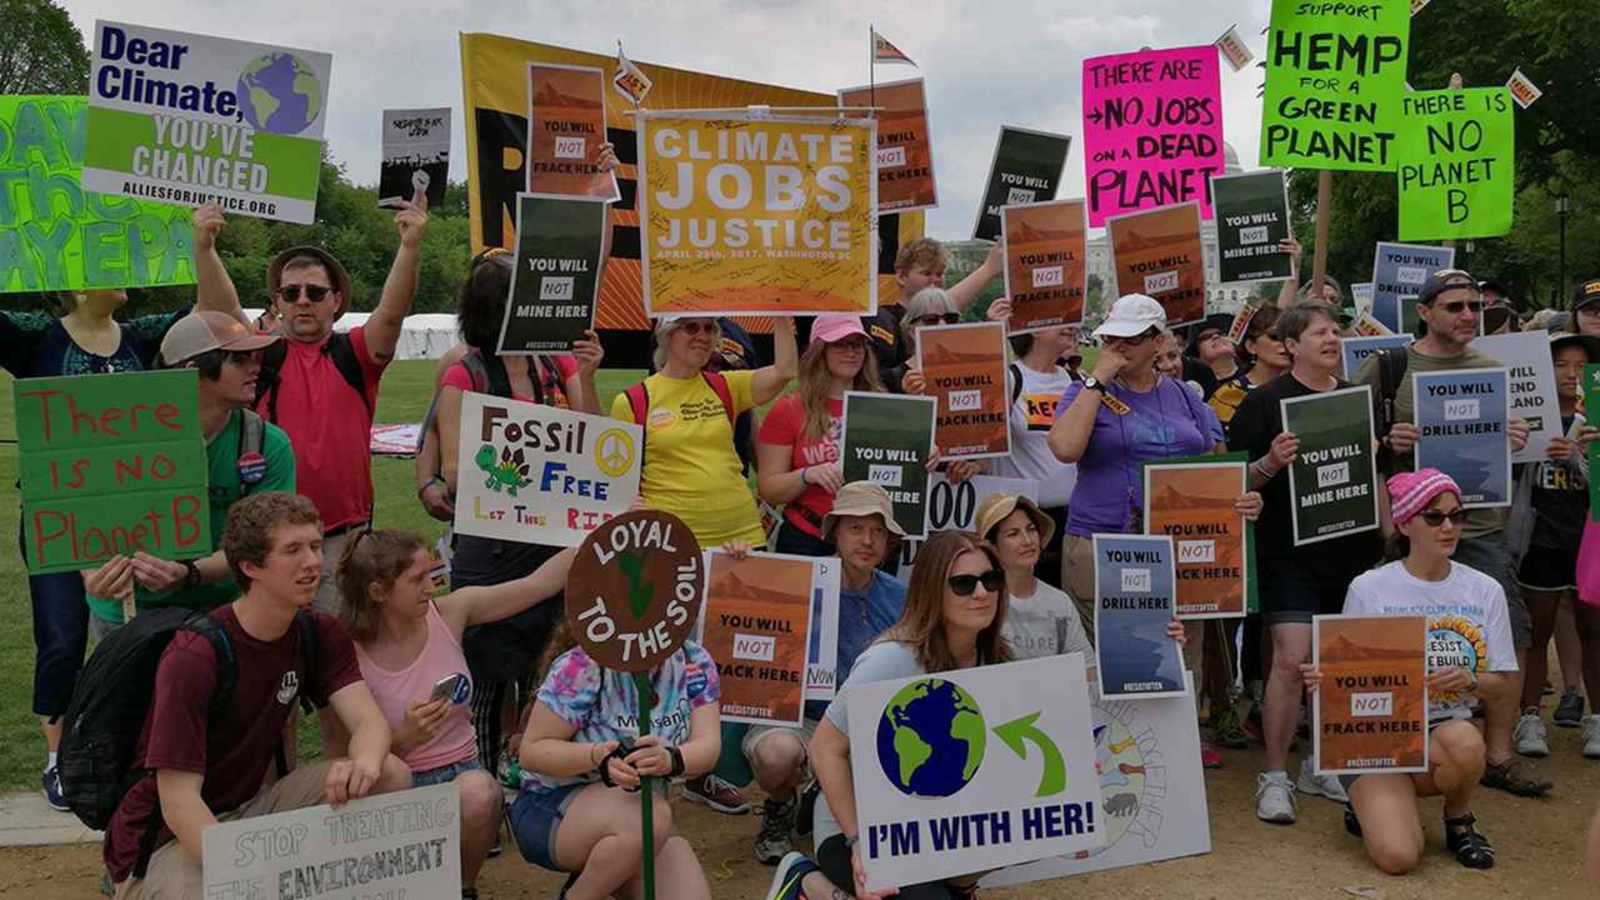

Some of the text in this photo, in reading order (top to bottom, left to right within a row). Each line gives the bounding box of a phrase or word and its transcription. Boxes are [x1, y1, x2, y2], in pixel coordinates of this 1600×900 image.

[1295, 2, 1383, 21] SUPPORT
[101, 26, 188, 70] Dear
[1274, 29, 1402, 77] HEMP
[1089, 59, 1203, 88] THERE ARE
[1299, 77, 1360, 94] FOR A
[97, 65, 243, 123] Climate,
[1278, 96, 1377, 125] GREEN
[1402, 93, 1507, 116] THERE IS
[1104, 96, 1215, 130] NO JOBS
[544, 120, 596, 134] YOU WILL
[154, 114, 254, 158] YOU'VE
[887, 130, 917, 142] WILL
[1426, 119, 1482, 155] NO
[557, 140, 583, 154] NOT
[654, 128, 854, 163] CLIMATE
[1093, 133, 1217, 162] ON A DEAD
[1267, 125, 1395, 165] PLANET
[132, 145, 268, 195] CHANGED
[533, 162, 601, 175] FRACK HER
[1402, 158, 1496, 191] PLANET
[655, 162, 851, 212] JOBS
[1001, 173, 1049, 190] YOU WILL
[1090, 166, 1218, 212] PLANET
[123, 181, 276, 216] ALLIESFORJUSTICE.ORG
[1447, 189, 1469, 224] B
[1225, 212, 1278, 227] YOU WILL
[657, 218, 851, 250] JUSTICE
[1243, 230, 1265, 241] NOT
[657, 250, 690, 259] APRIL
[1019, 251, 1075, 266] YOU WILL
[1223, 244, 1281, 259] MINE HER
[528, 258, 588, 272] YOU WILL
[1130, 254, 1190, 274] YOU WILL
[1387, 254, 1440, 267] YOU WILL
[1034, 269, 1062, 283] NOT
[1148, 276, 1176, 289] NOT
[1400, 270, 1423, 280] NOT
[543, 282, 571, 295] NOT
[1013, 287, 1082, 304] FRACK HERE
[1378, 283, 1409, 294] DRILL
[516, 305, 588, 318] MINE HERE
[1353, 349, 1374, 359] YO
[934, 375, 993, 388] YOU WILL
[1428, 383, 1494, 397] YOU WILL
[951, 394, 979, 406] NOT
[20, 389, 181, 442] There
[1449, 404, 1474, 416] NOT
[937, 412, 1004, 427] RACK HERE
[1423, 422, 1501, 436] DRILL HERE
[855, 447, 918, 462] YOU WILL
[1302, 443, 1361, 465] YOU WILL
[872, 470, 898, 481] NOT
[1320, 468, 1345, 481] NOT
[1301, 484, 1369, 507] MINE HERE
[33, 494, 201, 564] Planet B
[1163, 523, 1229, 536] YOU WILL
[593, 519, 677, 565] LOYAL
[1106, 550, 1162, 564] YOU WILL
[1181, 545, 1211, 558] NOT
[1124, 573, 1148, 587] NOT
[1204, 567, 1240, 579] HERE
[578, 556, 697, 661] TO THE SOIL
[1102, 598, 1136, 610] DRILL
[1138, 598, 1169, 610] HERE
[720, 614, 793, 633] YOU WILL
[737, 640, 771, 655] NOT
[1428, 641, 1463, 652] ESIST
[1437, 656, 1470, 667] BUILD
[716, 663, 799, 683] RACK HERE
[1335, 675, 1409, 689] YOU WILL
[1355, 698, 1390, 711] NOT
[1324, 721, 1420, 735] FRACK HERE
[234, 797, 456, 868] STOP TREATING
[868, 801, 1096, 859] I'M WITH HER!
[278, 837, 448, 900] ENVIRONMENT
